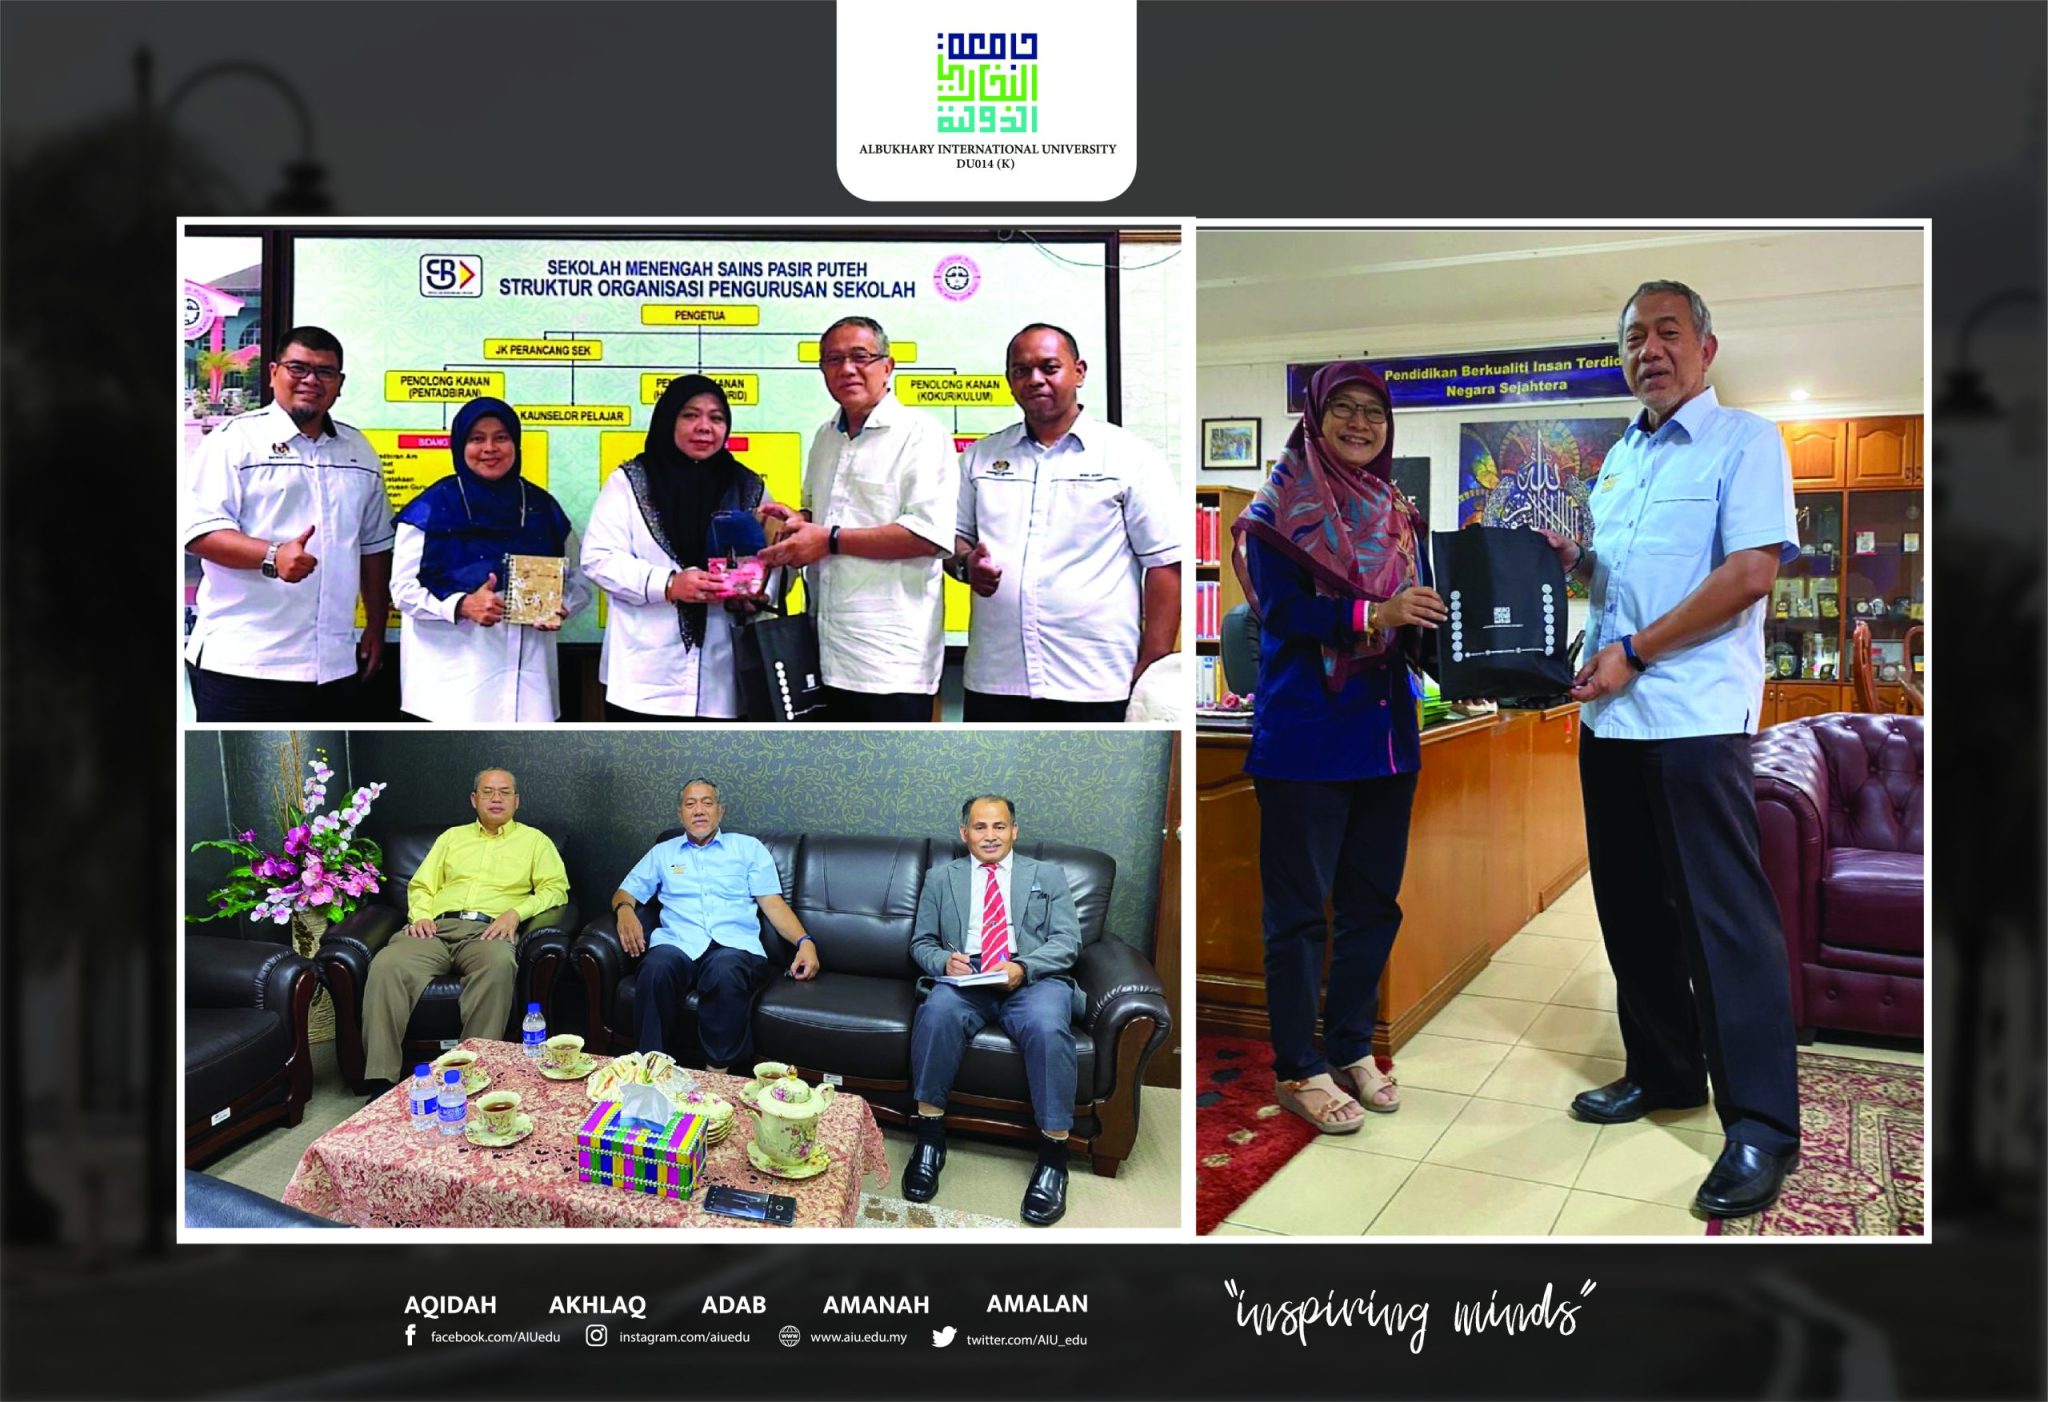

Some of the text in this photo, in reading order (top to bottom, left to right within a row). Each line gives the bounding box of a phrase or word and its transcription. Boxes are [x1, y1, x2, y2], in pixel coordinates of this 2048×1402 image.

[548, 260, 868, 277] SEKOLAH MENENGAH SAINS PASIR PUTEH
[500, 279, 916, 298] STRUKTUR ORGANISASI PENGURUSAN SEKOLAH
[675, 310, 726, 321] PENGETUA
[495, 345, 591, 355] JK PERANCANG SEK
[1384, 368, 1457, 382] Pendidikan
[1461, 362, 1529, 377] Berkualiti
[1533, 358, 1572, 373] Insan
[400, 375, 491, 387] PENOLONG KANAN
[910, 380, 1000, 389] PENOLONG KANAN
[408, 387, 482, 399] (PENTADBIRAN)
[1446, 380, 1568, 398] Negara Sejahtera
[917, 391, 993, 402] (KOKURIKULUM)
[520, 410, 624, 422] KAUNSELOR PELAJAR
